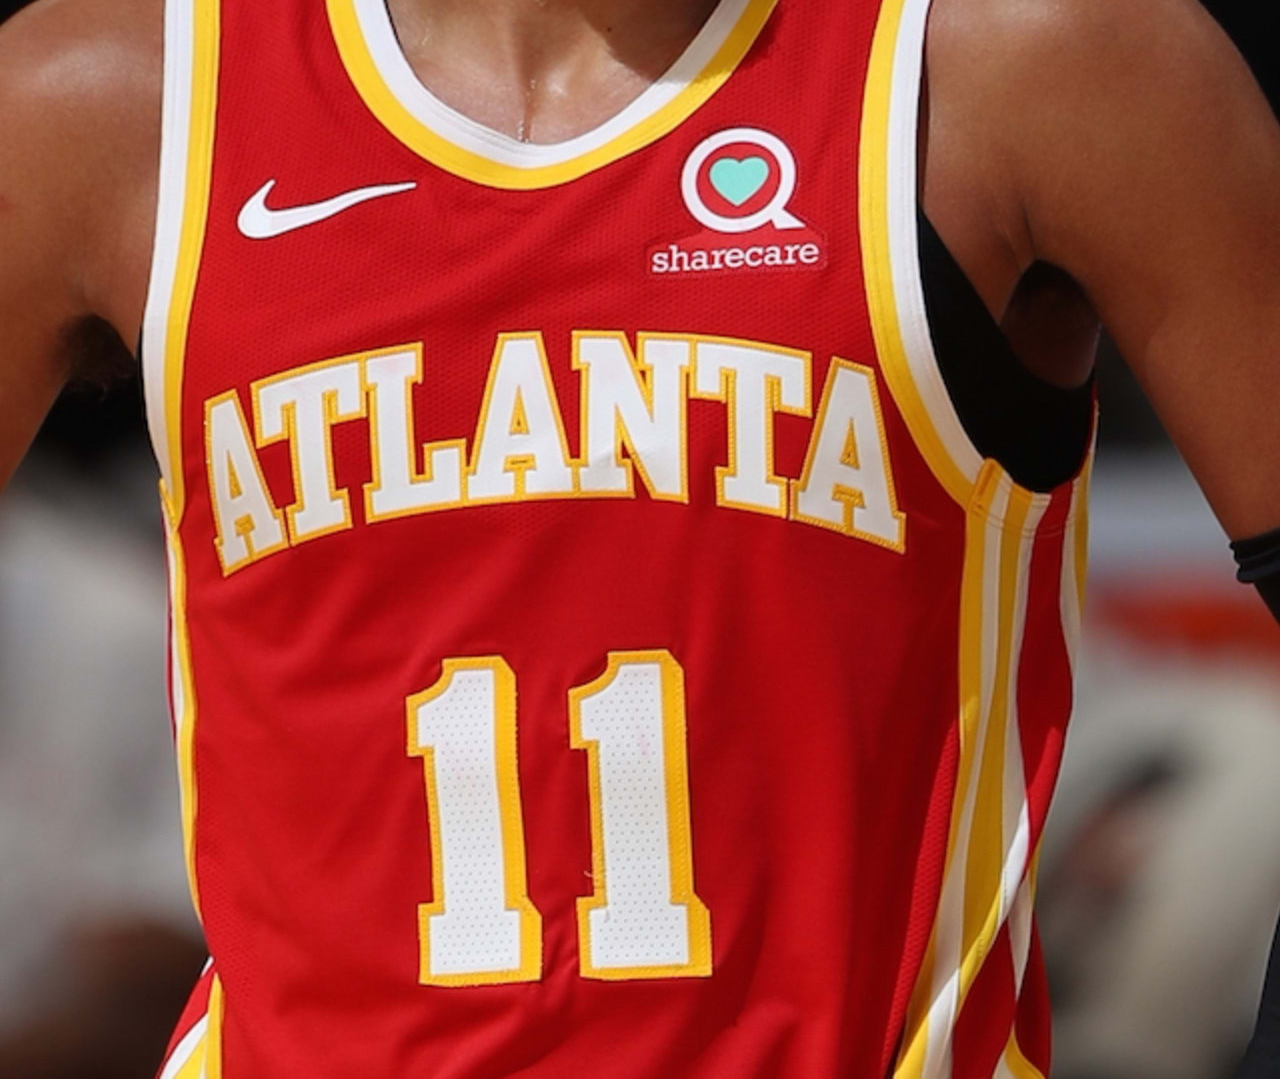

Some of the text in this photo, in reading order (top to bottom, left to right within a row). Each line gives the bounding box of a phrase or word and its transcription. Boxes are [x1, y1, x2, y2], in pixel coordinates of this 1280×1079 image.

[652, 243, 819, 272] sharecare
[205, 330, 907, 577] ATLANTA
[406, 649, 713, 987] 11
